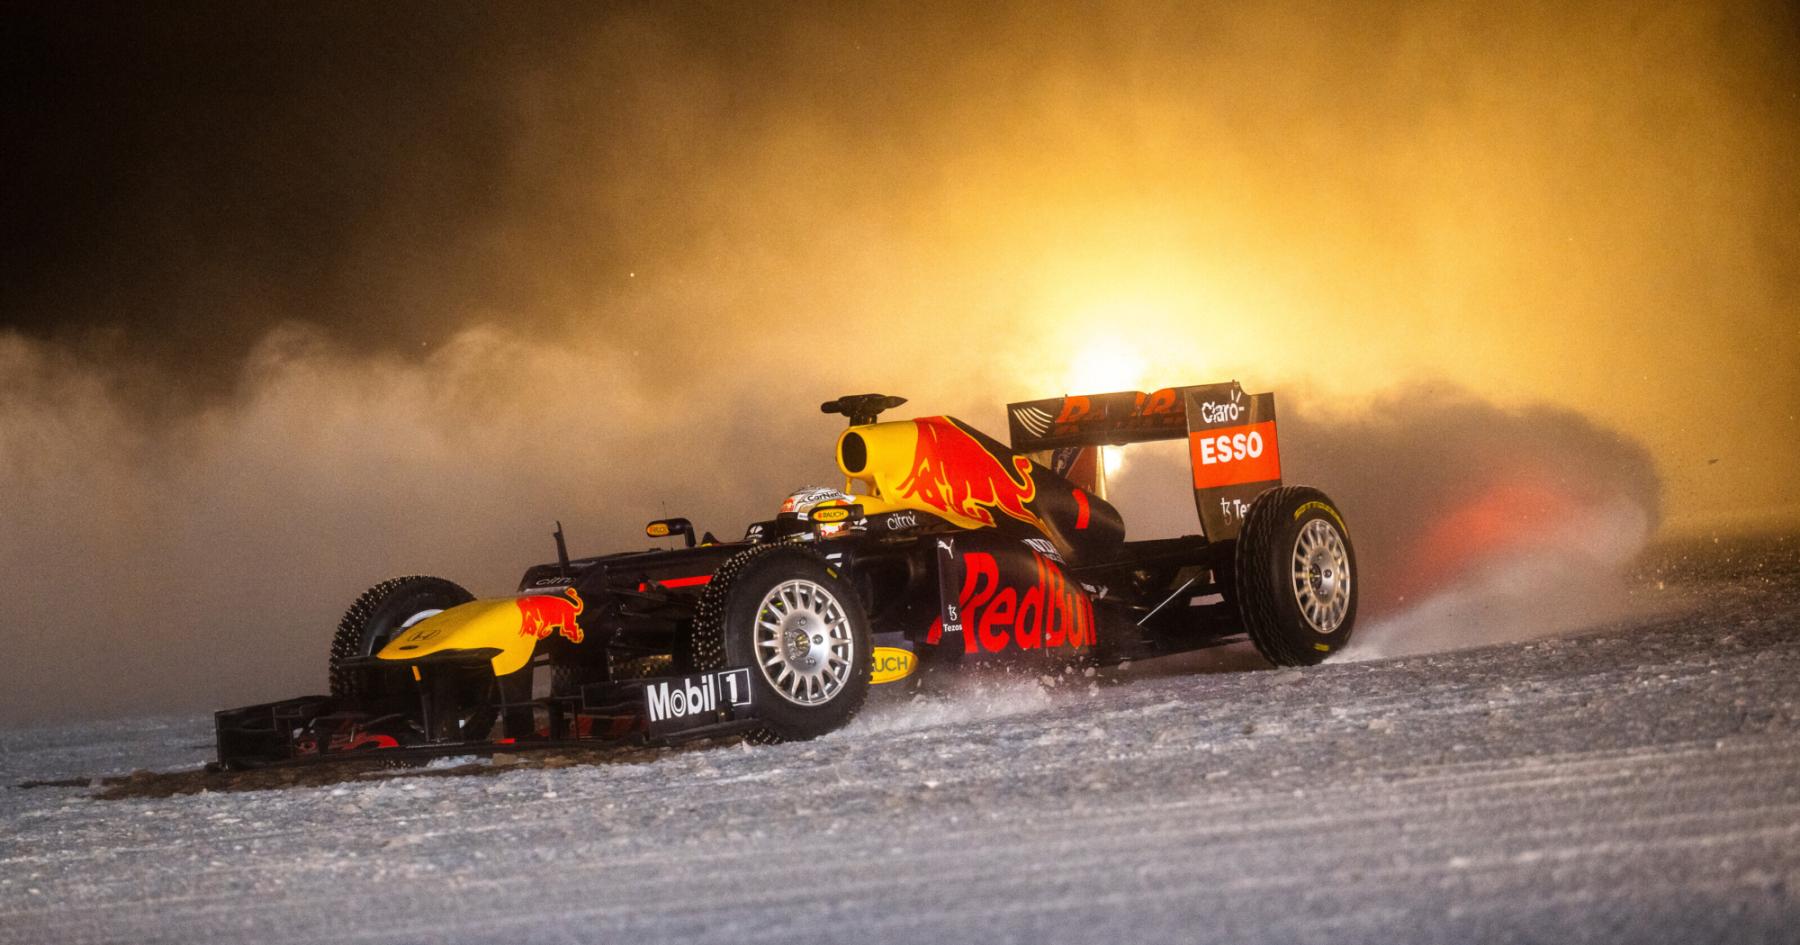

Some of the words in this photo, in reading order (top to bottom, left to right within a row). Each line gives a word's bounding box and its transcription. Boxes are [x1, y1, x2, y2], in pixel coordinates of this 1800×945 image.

[1201, 401, 1239, 423] Claro
[1200, 431, 1263, 464] ESSO
[887, 511, 917, 530] citrix
[943, 623, 963, 632] Tezos
[873, 655, 908, 673] UCH
[647, 673, 716, 722] Mobil
[725, 673, 737, 702] 1
